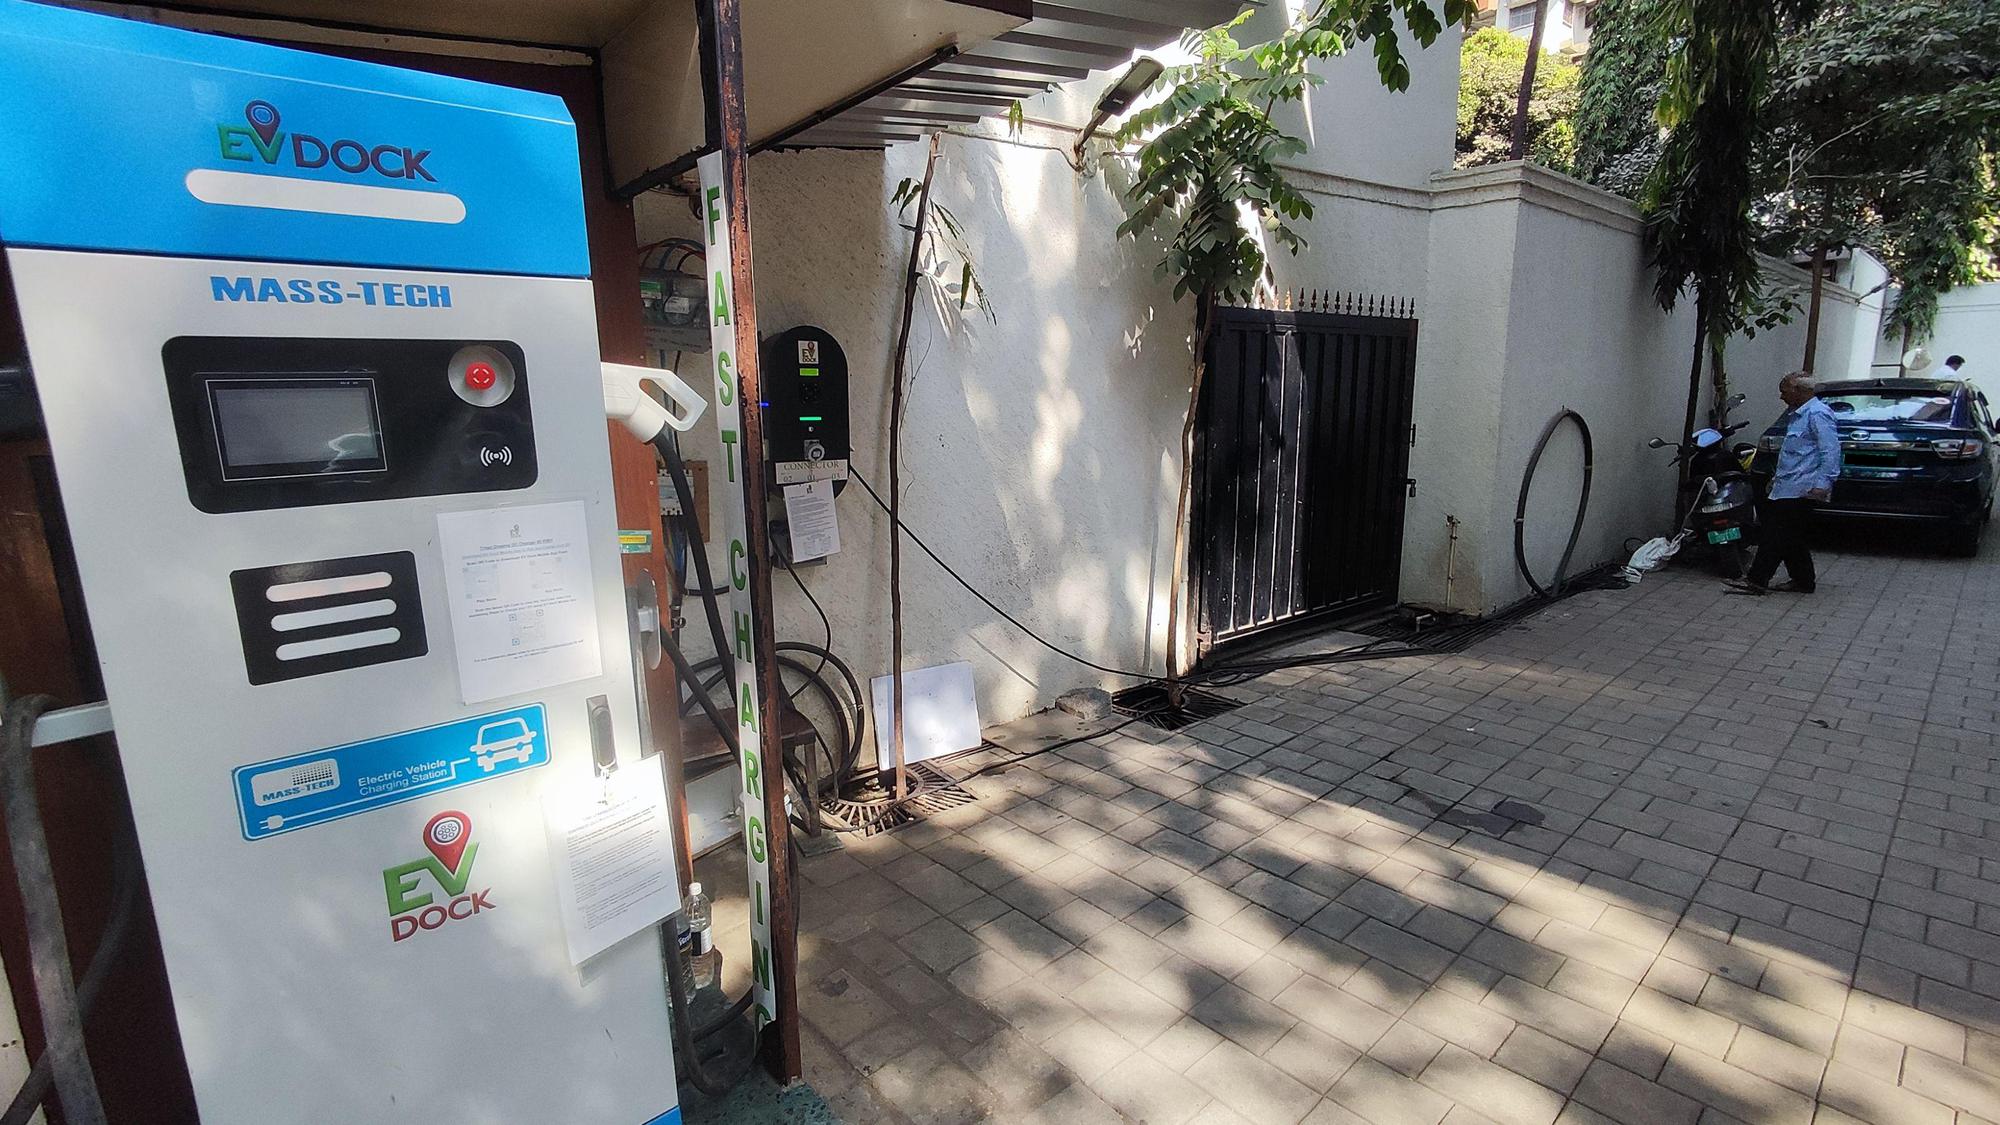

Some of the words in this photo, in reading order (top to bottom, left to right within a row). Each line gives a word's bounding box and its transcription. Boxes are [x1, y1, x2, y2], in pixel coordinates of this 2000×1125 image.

[217, 122, 286, 165] EV
[291, 133, 439, 183] DOCK
[210, 275, 453, 308] MASS-TECH
[706, 186, 737, 483] FAST
[783, 461, 840, 471] CONNECTOR
[358, 770, 403, 787] Electric
[406, 759, 447, 776] Vehicle
[359, 777, 409, 797] Charging
[411, 768, 448, 784] Station
[262, 778, 334, 802] MASS-TECH
[383, 841, 480, 917] EV
[391, 887, 497, 942] DOCK
